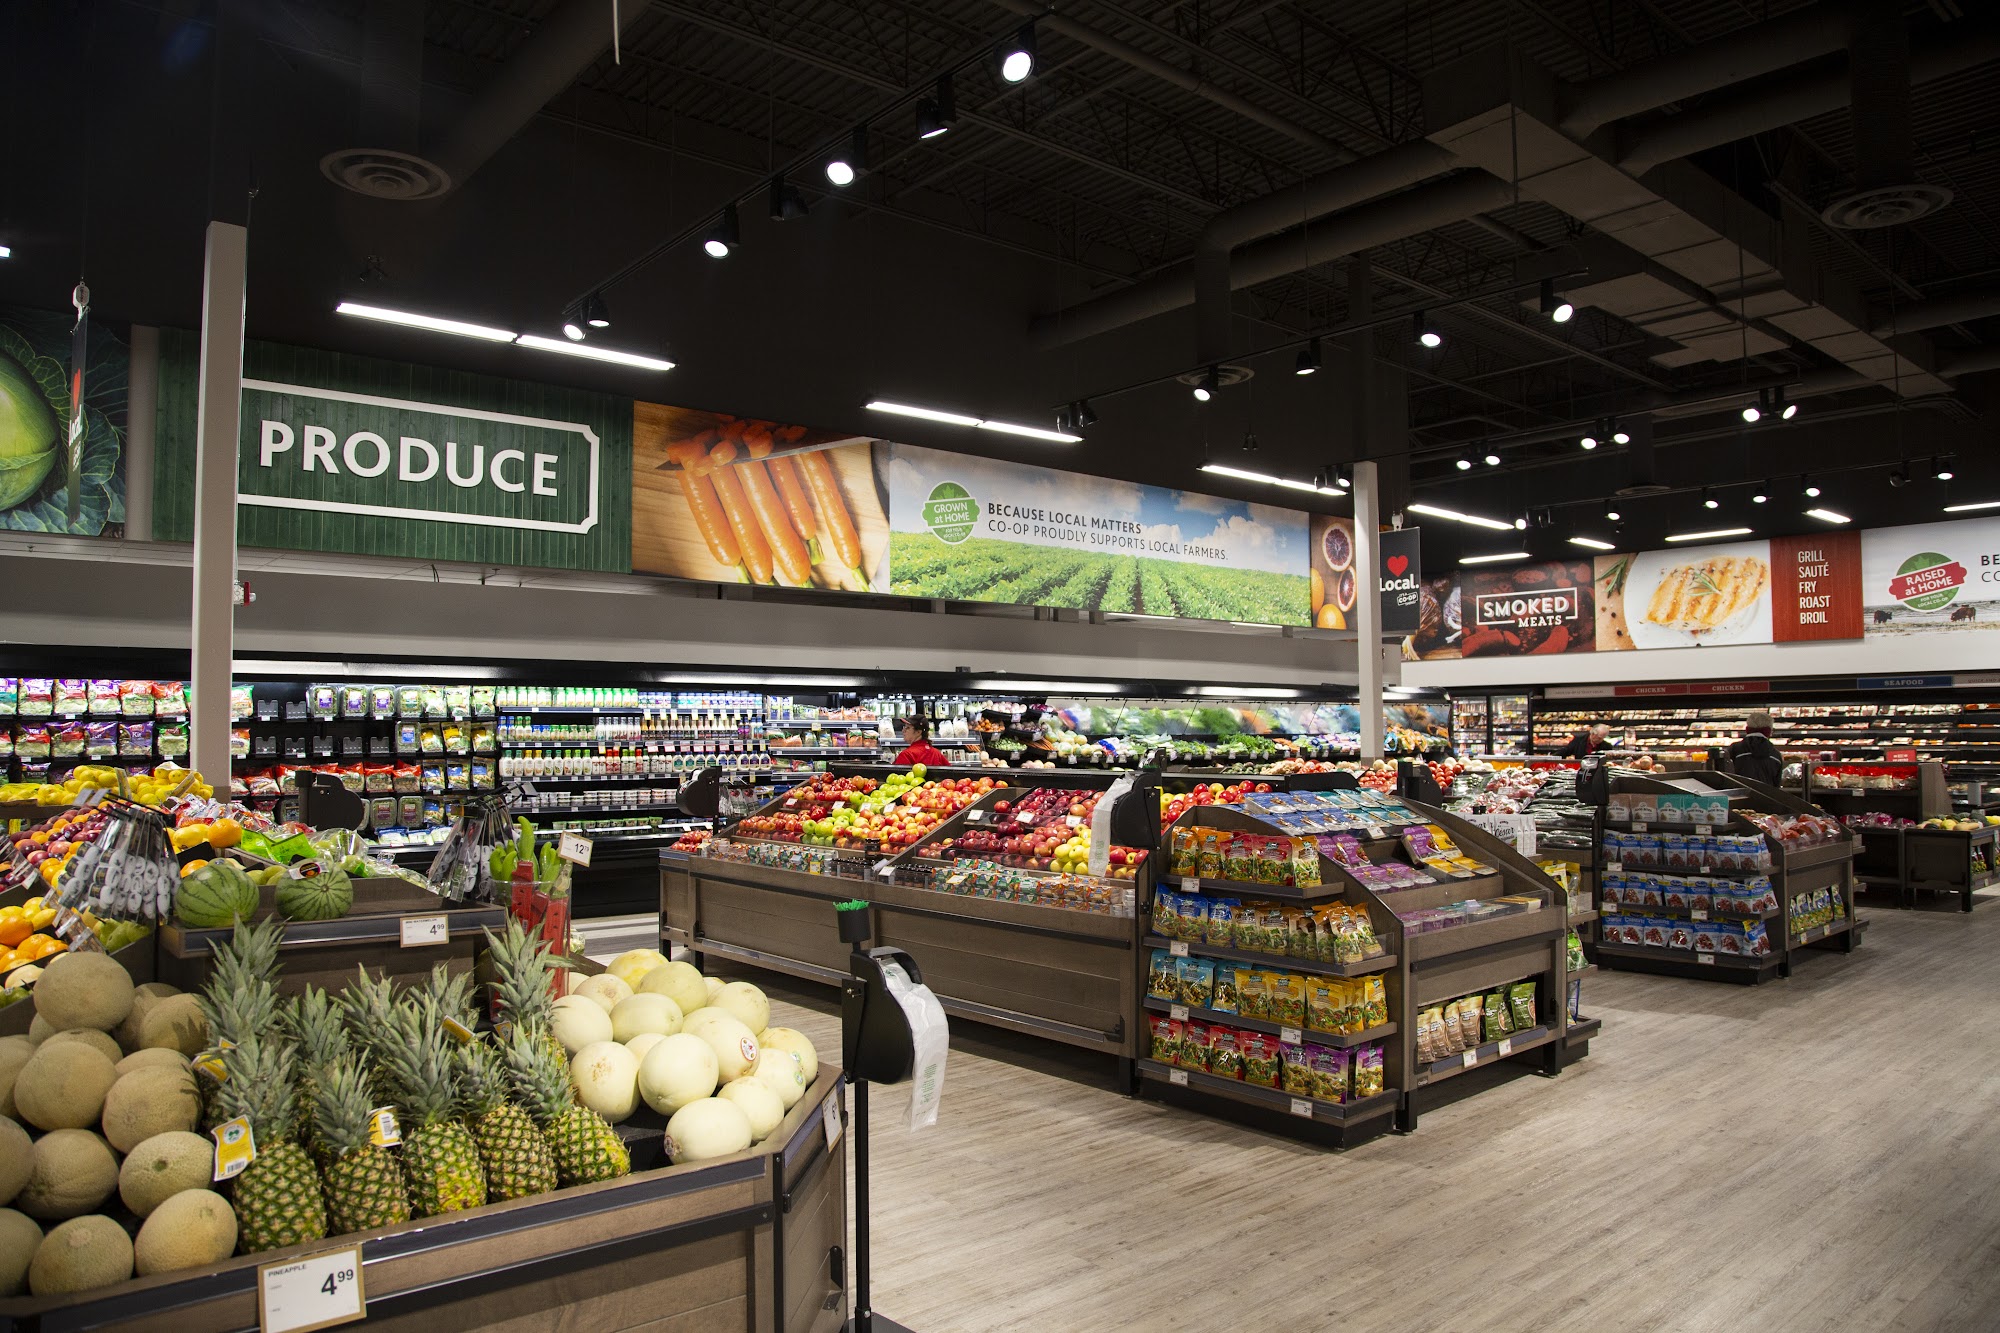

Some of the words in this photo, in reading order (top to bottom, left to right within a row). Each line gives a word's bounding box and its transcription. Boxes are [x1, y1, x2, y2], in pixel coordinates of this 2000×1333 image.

[260, 420, 559, 497] PRODUCE
[933, 502, 968, 513] GROWN
[935, 515, 943, 524] at
[944, 512, 970, 522] HOME
[988, 503, 1044, 522] BECAUSE
[1049, 511, 1087, 527] LOCAL
[1091, 518, 1142, 534] MATTERS
[988, 519, 1029, 535] CO-OP
[1034, 526, 1087, 544] PROUDLY
[1090, 532, 1145, 550] SUPPORTS
[1149, 540, 1181, 555] LOCAL
[1183, 544, 1229, 560] FARMERS.
[1798, 550, 1825, 563] GRILL
[1798, 562, 1830, 579] SAUTÉ
[1906, 568, 1947, 586] RAISED
[1799, 581, 1817, 594] FRY
[1905, 586, 1916, 596] at
[1918, 576, 1954, 592] HOME
[1483, 596, 1570, 618] SMOKED
[1800, 595, 1831, 609] ROAST
[1518, 615, 1562, 628] MEATS
[1800, 611, 1828, 625] BROIL
[1711, 684, 1745, 692] CHICKEN
[268, 1264, 307, 1277] PINEAPPLE
